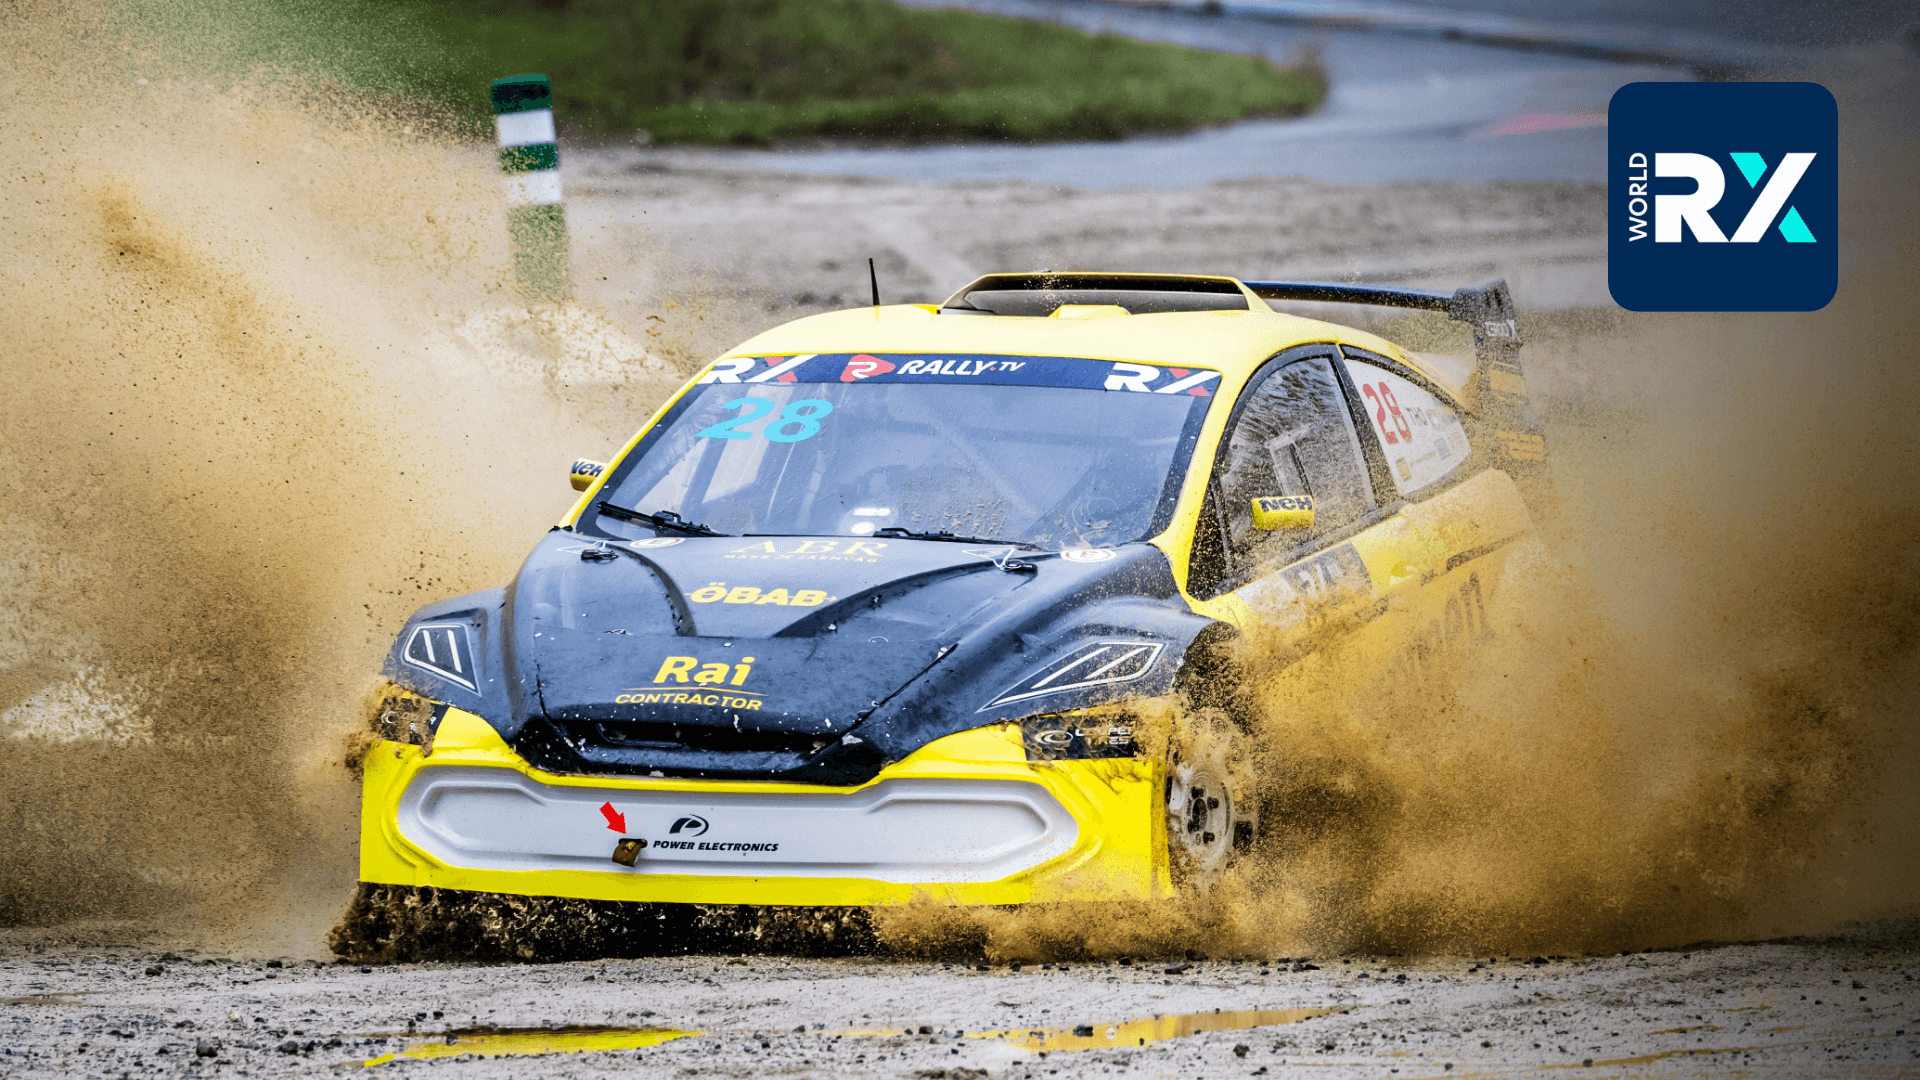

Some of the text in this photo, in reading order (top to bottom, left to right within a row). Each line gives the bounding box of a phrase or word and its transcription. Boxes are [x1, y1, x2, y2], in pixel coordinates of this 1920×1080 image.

[697, 354, 818, 384] RX
[1103, 361, 1222, 397] RX
[695, 397, 834, 443] 28
[1362, 381, 1413, 445] 28
[730, 540, 889, 557] ABR
[689, 582, 829, 607] ÖBAB
[652, 655, 756, 687] Rai
[614, 692, 763, 711] CONTRACTOR
[652, 840, 779, 852] POWER ELECTRONICS
